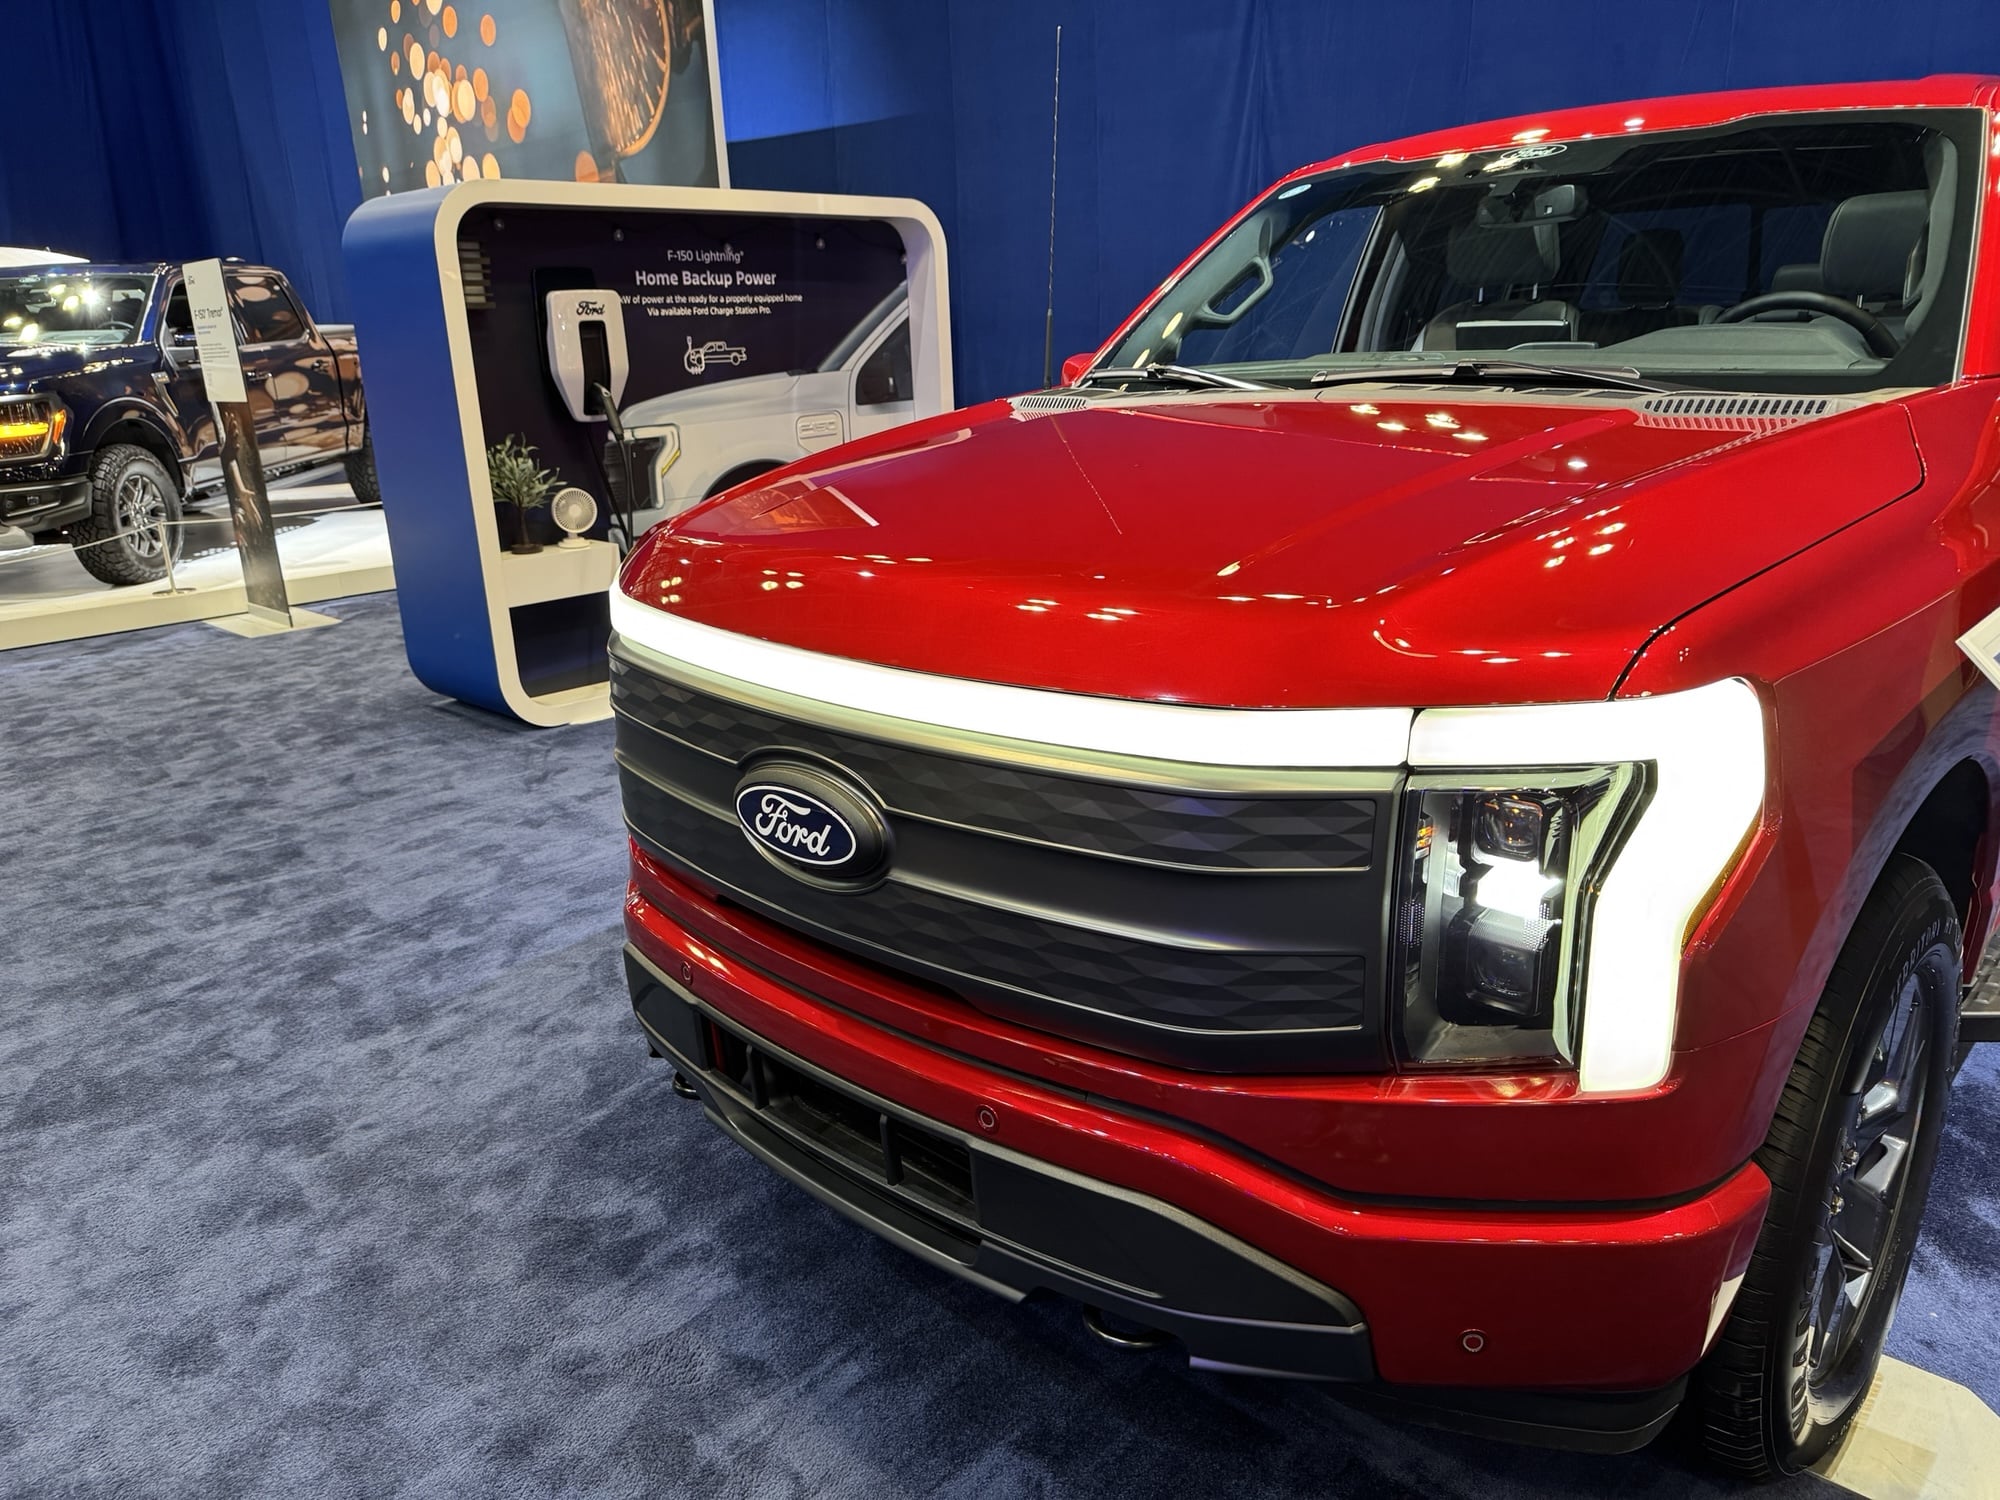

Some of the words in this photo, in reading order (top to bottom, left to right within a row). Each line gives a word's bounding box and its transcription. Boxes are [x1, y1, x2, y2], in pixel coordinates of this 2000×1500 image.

[667, 249, 694, 262] F-150
[635, 270, 679, 286] Home
[681, 270, 733, 288] Backup
[735, 270, 776, 286] Power
[632, 294, 641, 304] of
[641, 295, 665, 306] power
[665, 295, 674, 304] at
[674, 294, 687, 304] the
[688, 294, 707, 305] ready
[708, 294, 719, 304] for
[719, 295, 725, 303] a
[725, 294, 753, 304] properly
[753, 293, 784, 304] equipped
[784, 293, 803, 302] home
[576, 300, 605, 316] Ford
[646, 307, 660, 317] Via
[660, 306, 692, 316] available
[692, 306, 709, 316] Ford
[710, 306, 734, 317] Charge
[734, 306, 758, 315] Station
[758, 305, 772, 315] Pro.
[755, 793, 832, 857] Ford
